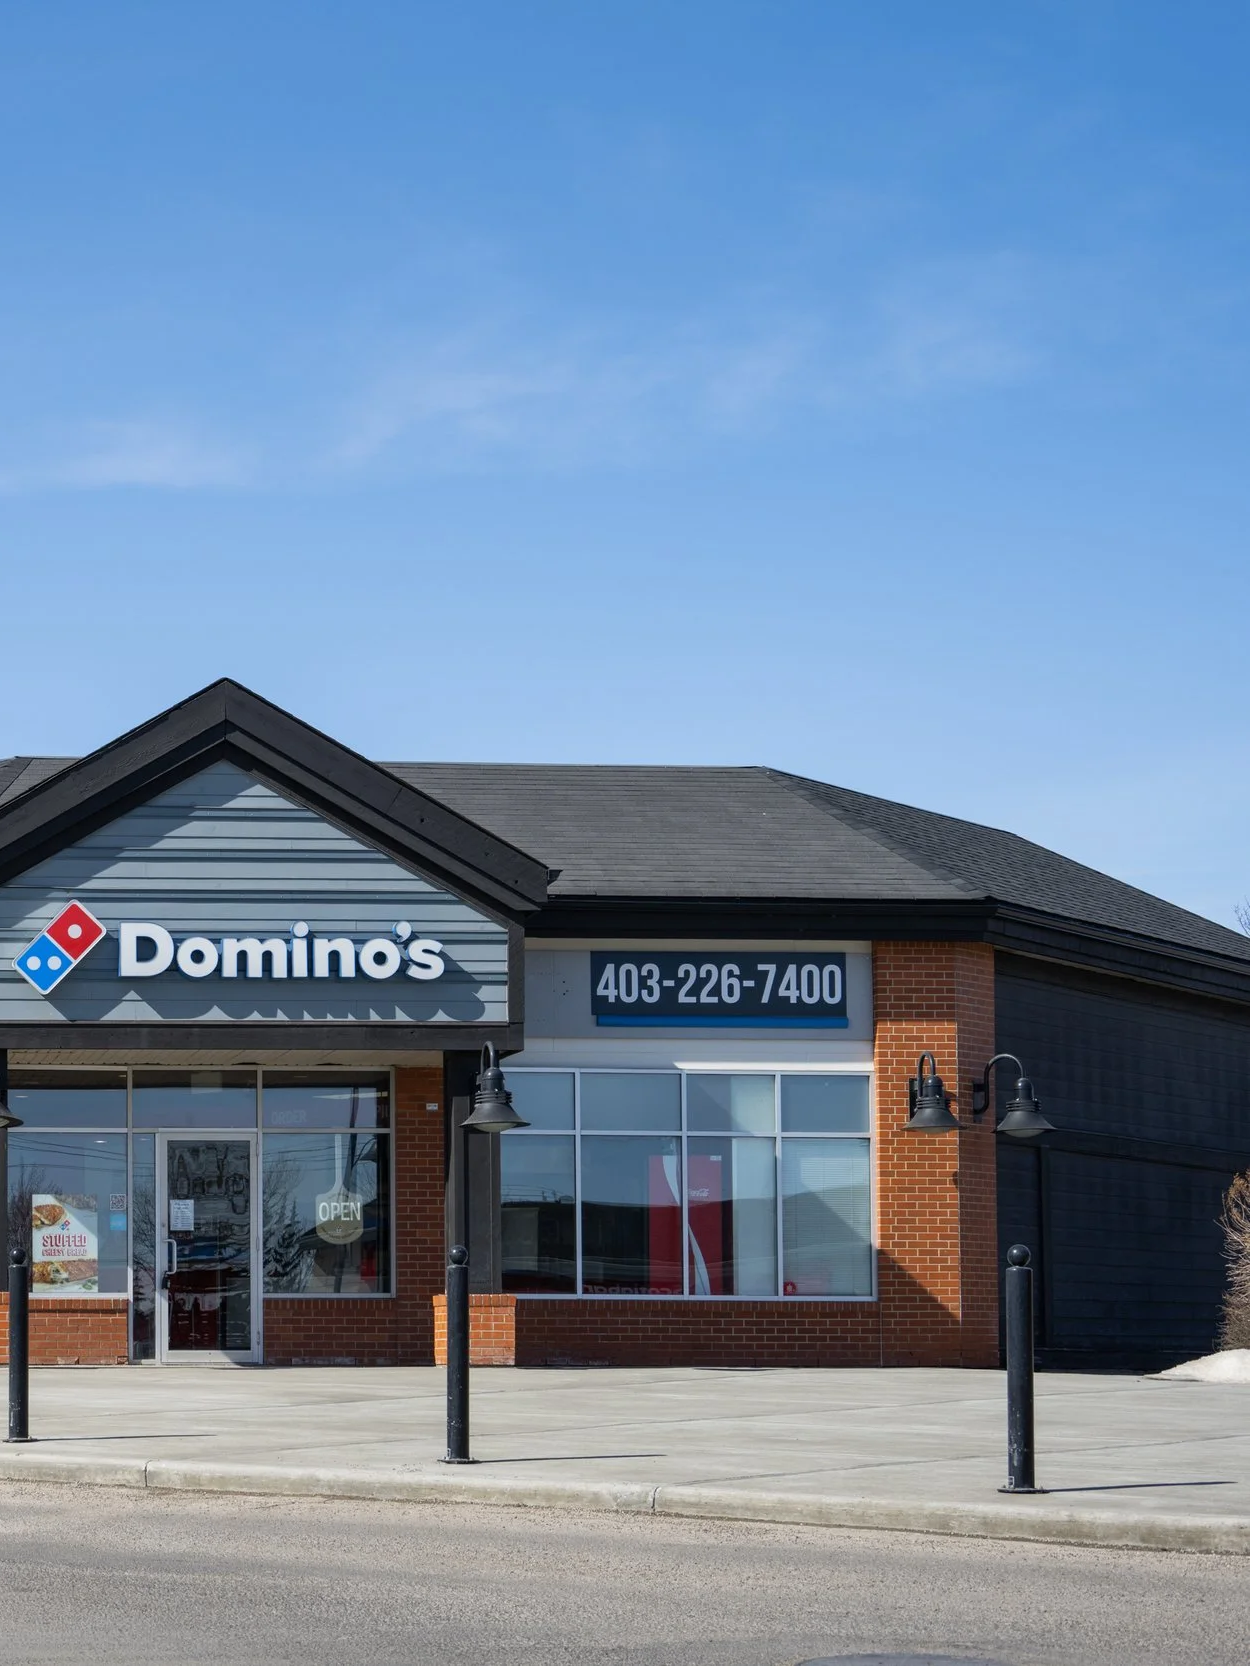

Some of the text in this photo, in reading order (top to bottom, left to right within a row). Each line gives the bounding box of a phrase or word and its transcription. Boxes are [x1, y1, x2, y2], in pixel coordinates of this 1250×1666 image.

[118, 920, 445, 980] Domino's
[597, 963, 842, 1004] 403-226-7400
[319, 1202, 361, 1221] OPEN
[42, 1234, 87, 1247] STUFFED
